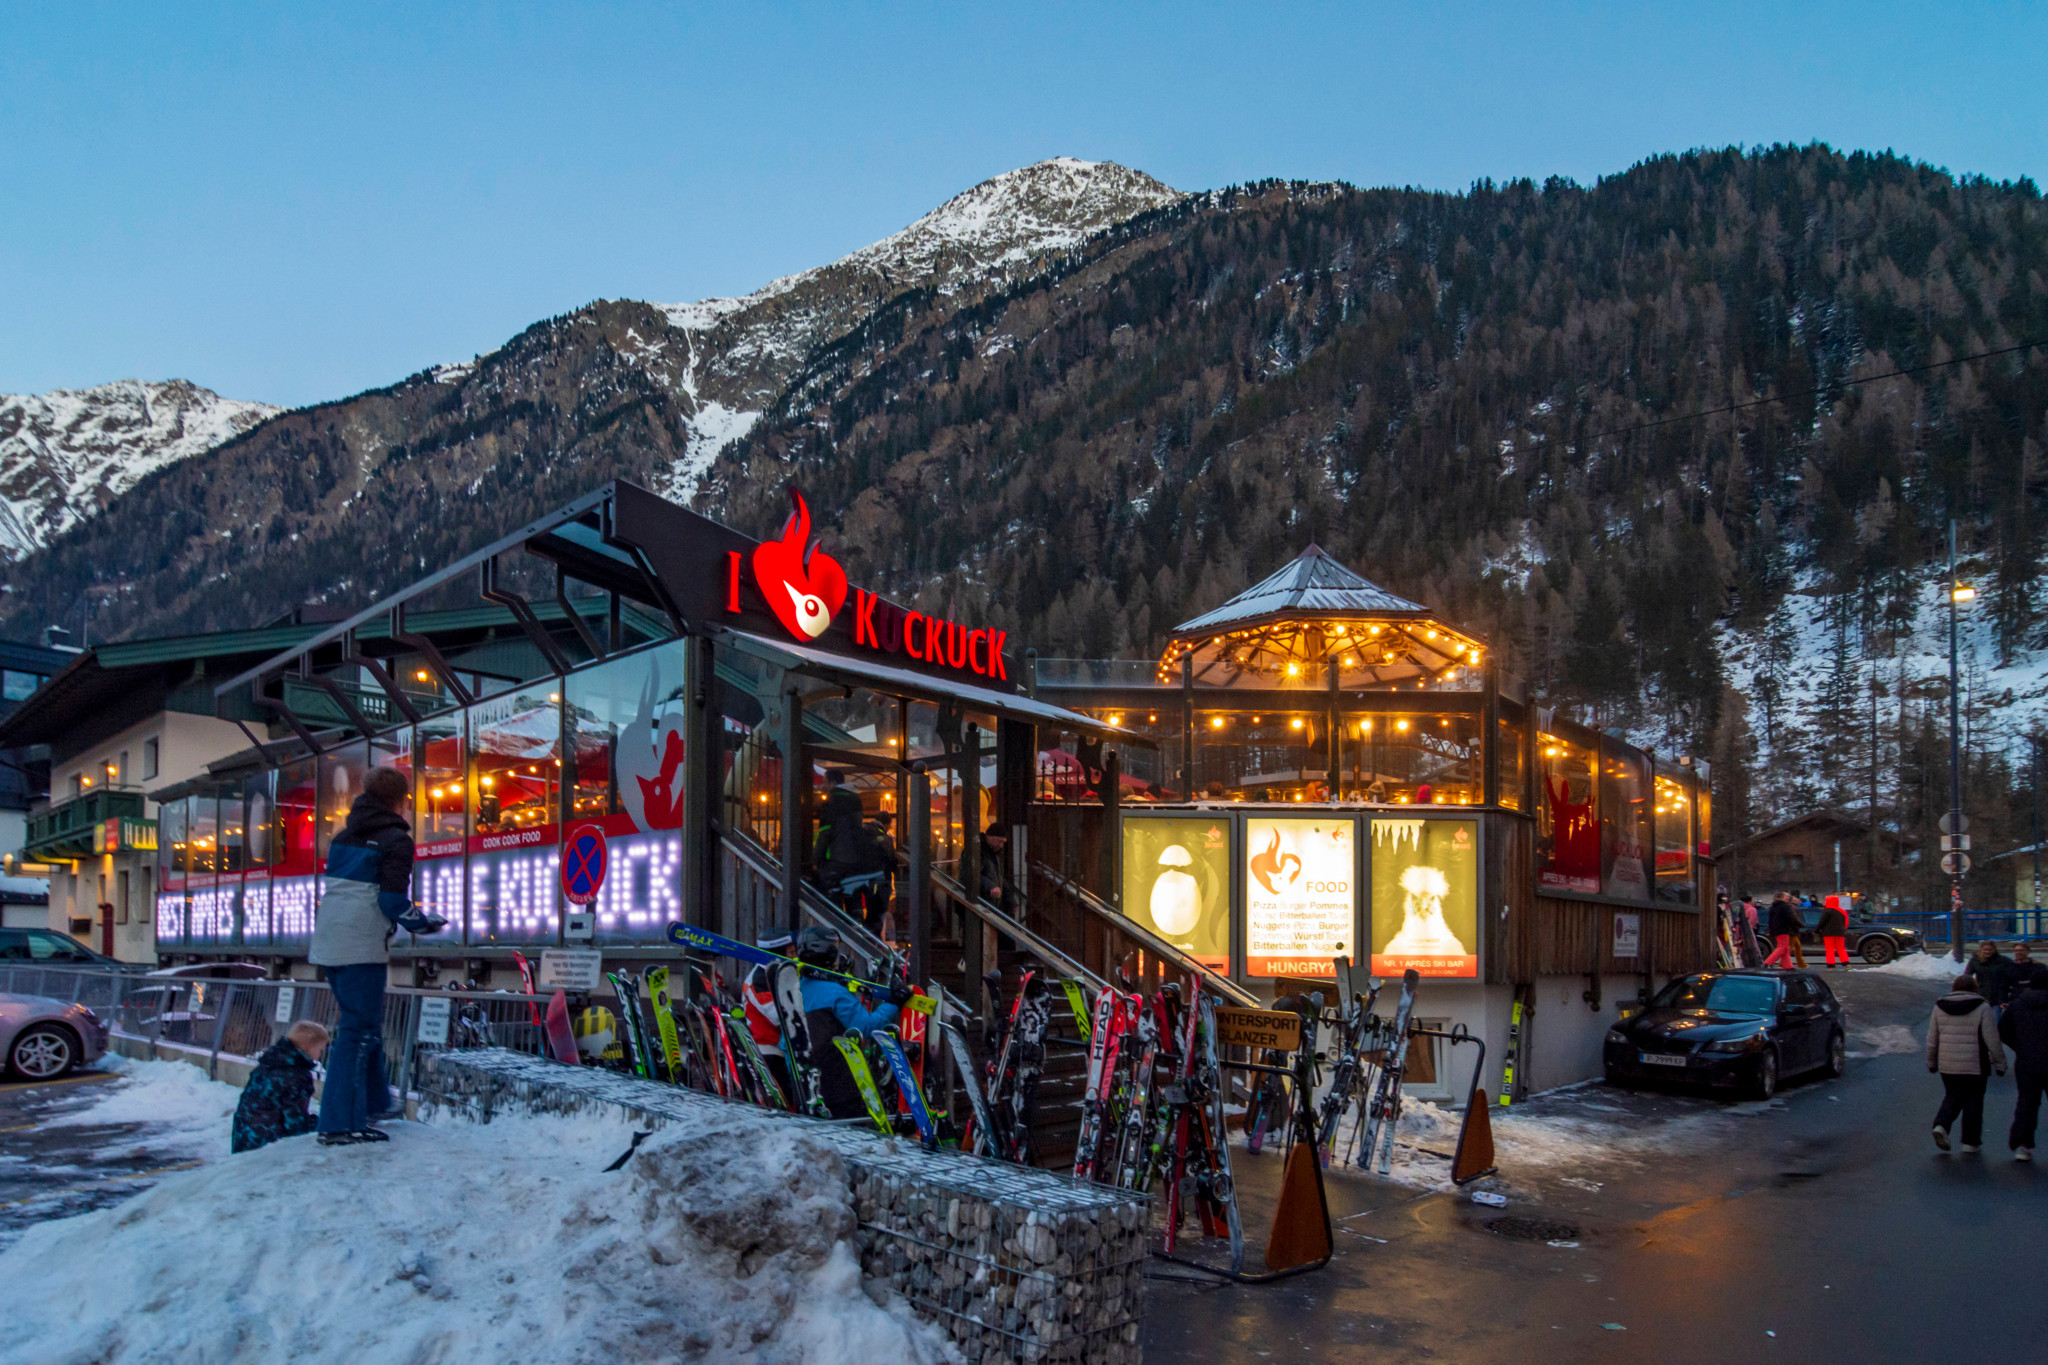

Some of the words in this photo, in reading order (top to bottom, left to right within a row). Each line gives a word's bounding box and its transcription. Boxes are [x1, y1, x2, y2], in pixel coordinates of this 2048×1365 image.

[726, 551, 742, 614] I
[856, 588, 1007, 681] KUCKUCK
[483, 837, 501, 849] COOK
[502, 833, 521, 846] COOK
[522, 830, 541, 843] FOOD
[1306, 881, 1348, 893] FOOD
[272, 881, 326, 934] PART
[1253, 901, 1277, 909] Pizza
[1310, 901, 1349, 910] Pommes
[1279, 911, 1327, 919] Bitterballen
[1253, 921, 1290, 931] Nuggets
[1319, 921, 1349, 931] Burger
[1253, 941, 1308, 950] Bitterballen
[1266, 961, 1335, 974] HUNGRY?
[1433, 960, 1446, 968] SKI
[1093, 1000, 1110, 1060] HEAD
[1219, 1028, 1278, 1046] GLANZER
